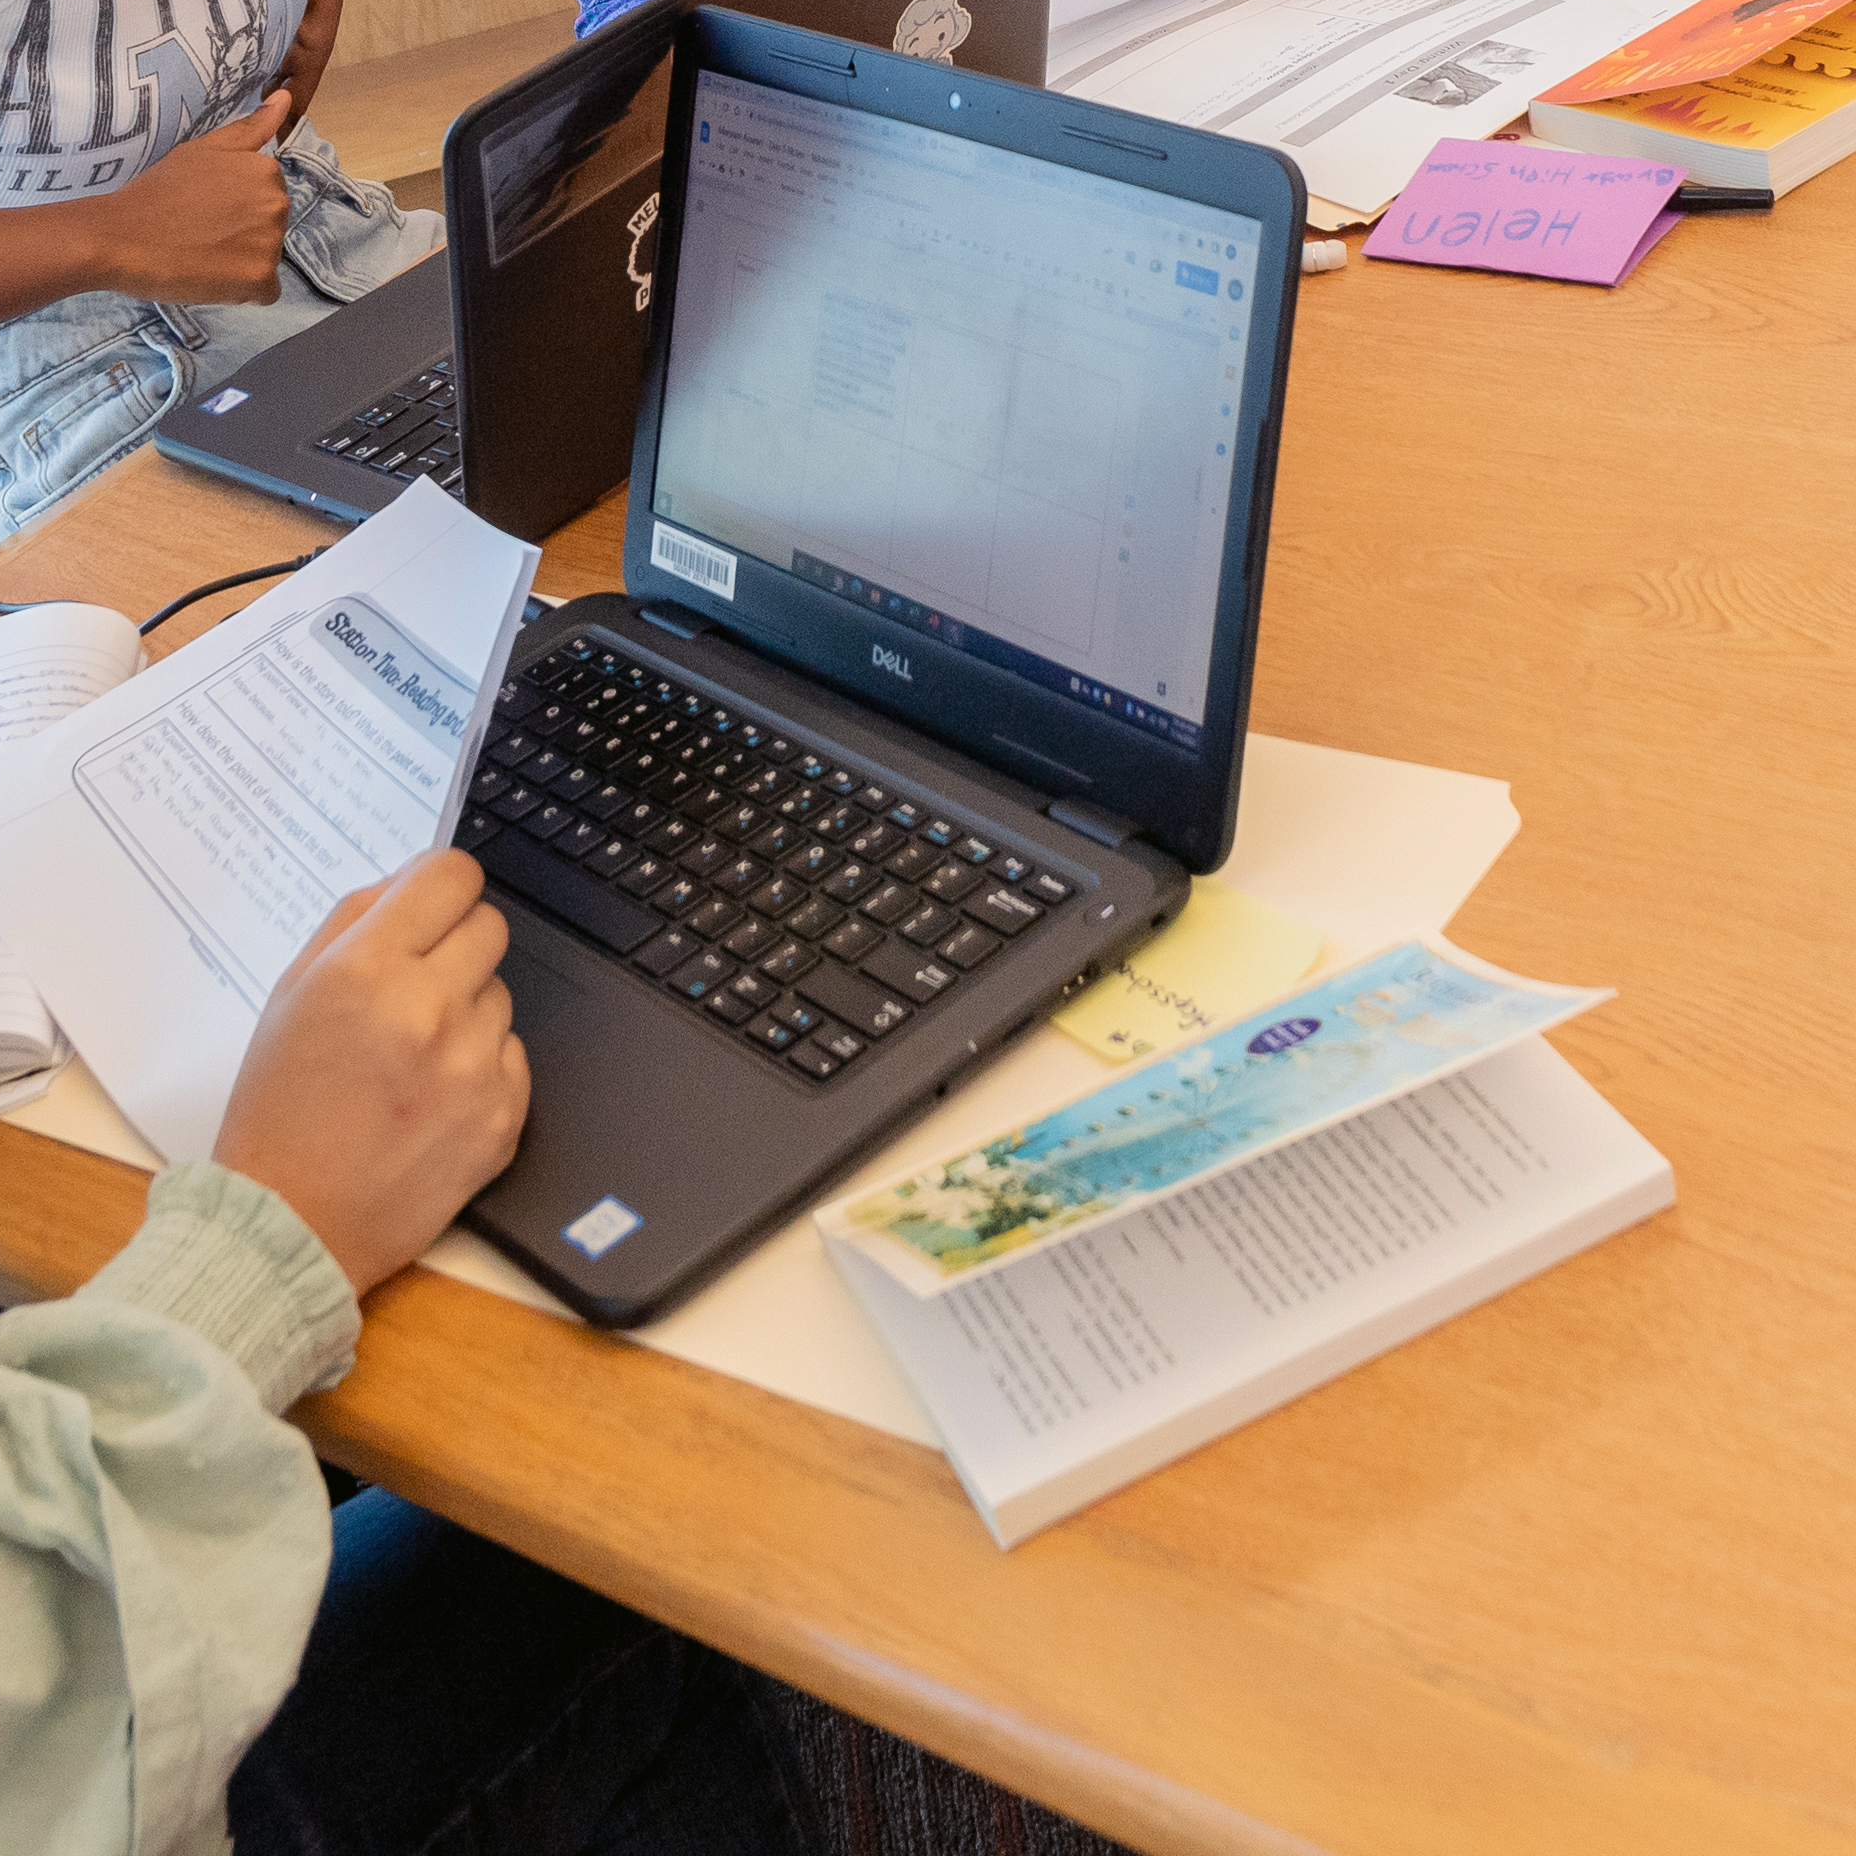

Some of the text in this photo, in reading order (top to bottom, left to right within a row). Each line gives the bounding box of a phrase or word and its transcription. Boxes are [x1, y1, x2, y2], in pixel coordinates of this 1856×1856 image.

[1398, 60, 1421, 78] Day
[1400, 208, 1581, 246] Helen
[268, 633, 418, 773] How is the story told? What point
[321, 606, 455, 728] Station Two: Reading
[871, 642, 913, 683] DELL
[174, 697, 343, 875] How does the point of view impact the story?
